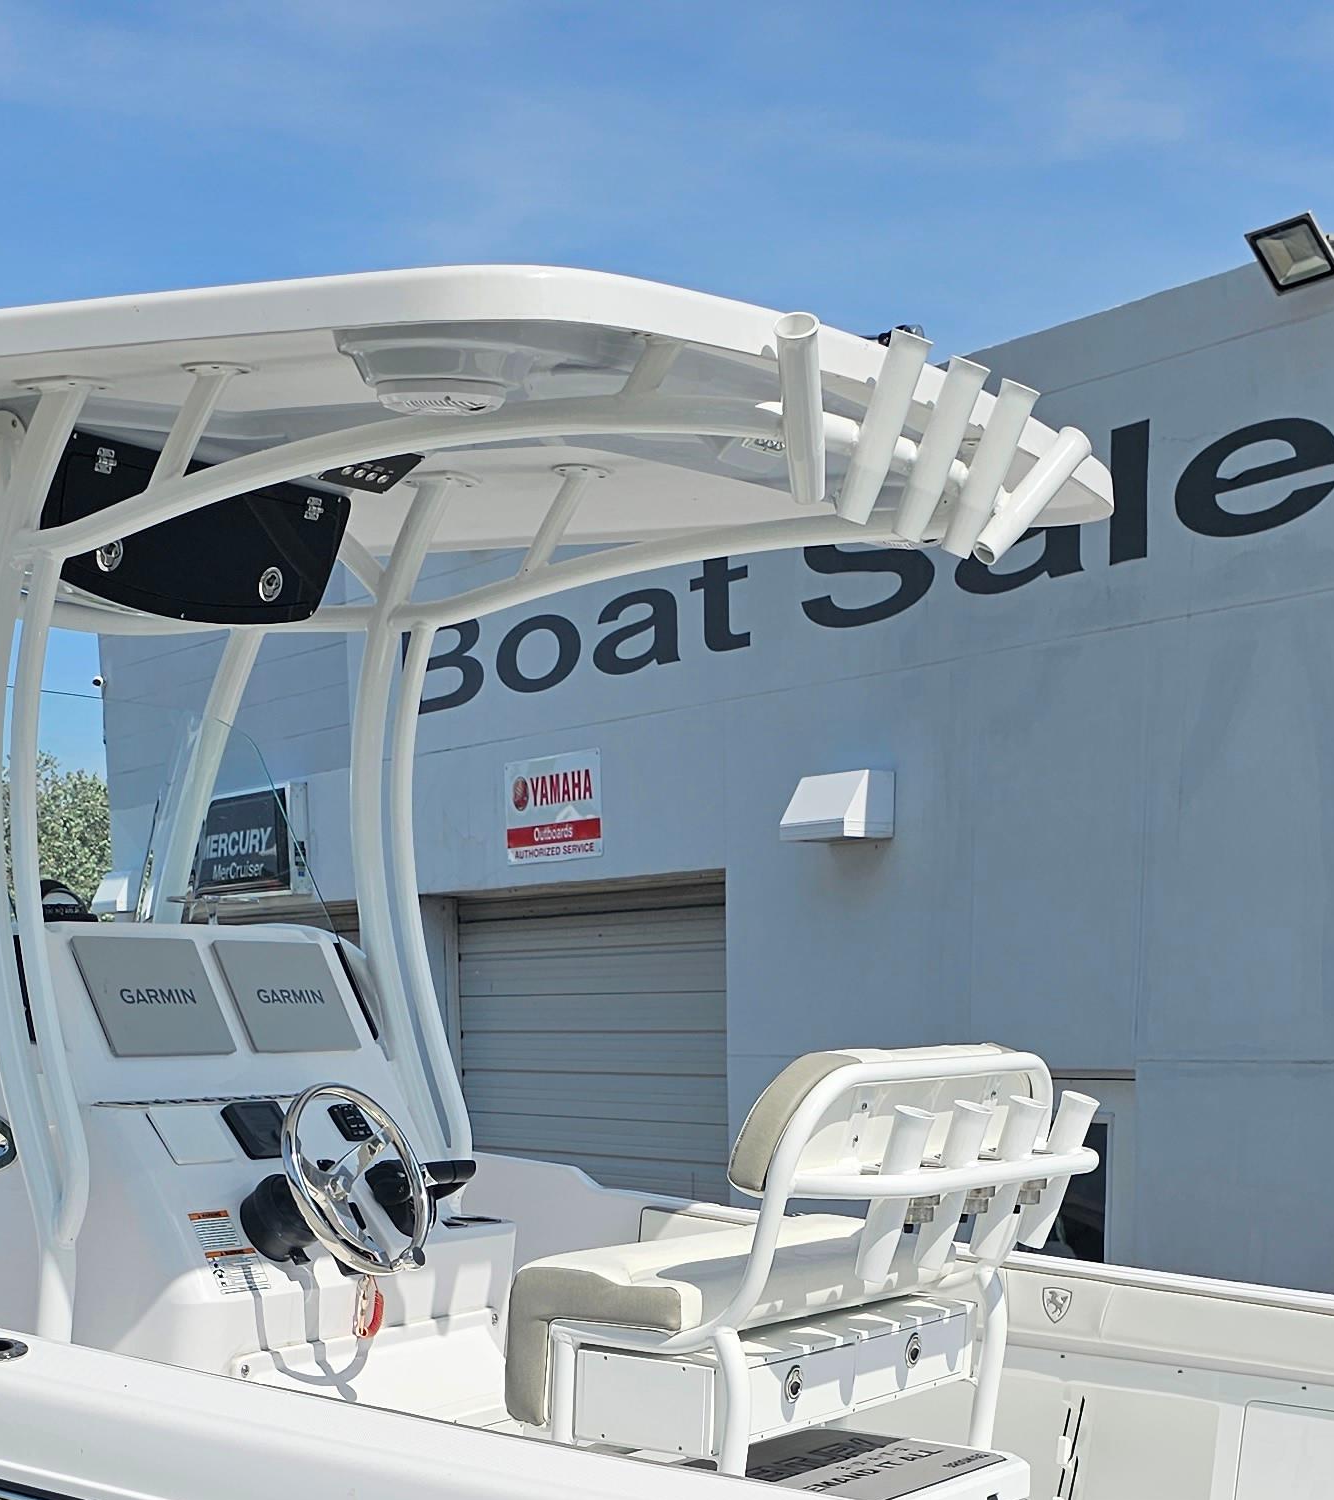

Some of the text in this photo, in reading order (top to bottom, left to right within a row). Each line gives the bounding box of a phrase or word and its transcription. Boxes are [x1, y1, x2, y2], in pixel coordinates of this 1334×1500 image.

[402, 557, 752, 716] Boat
[530, 769, 593, 807] YAMAHA
[533, 825, 573, 842] Outboards
[514, 842, 595, 860] AUTHORIZED SERVICE
[212, 861, 265, 881] MerCruiser
[120, 988, 197, 1005] GARMIN
[257, 989, 326, 1004] GARMIN
[803, 1468, 881, 1492] EMAND
